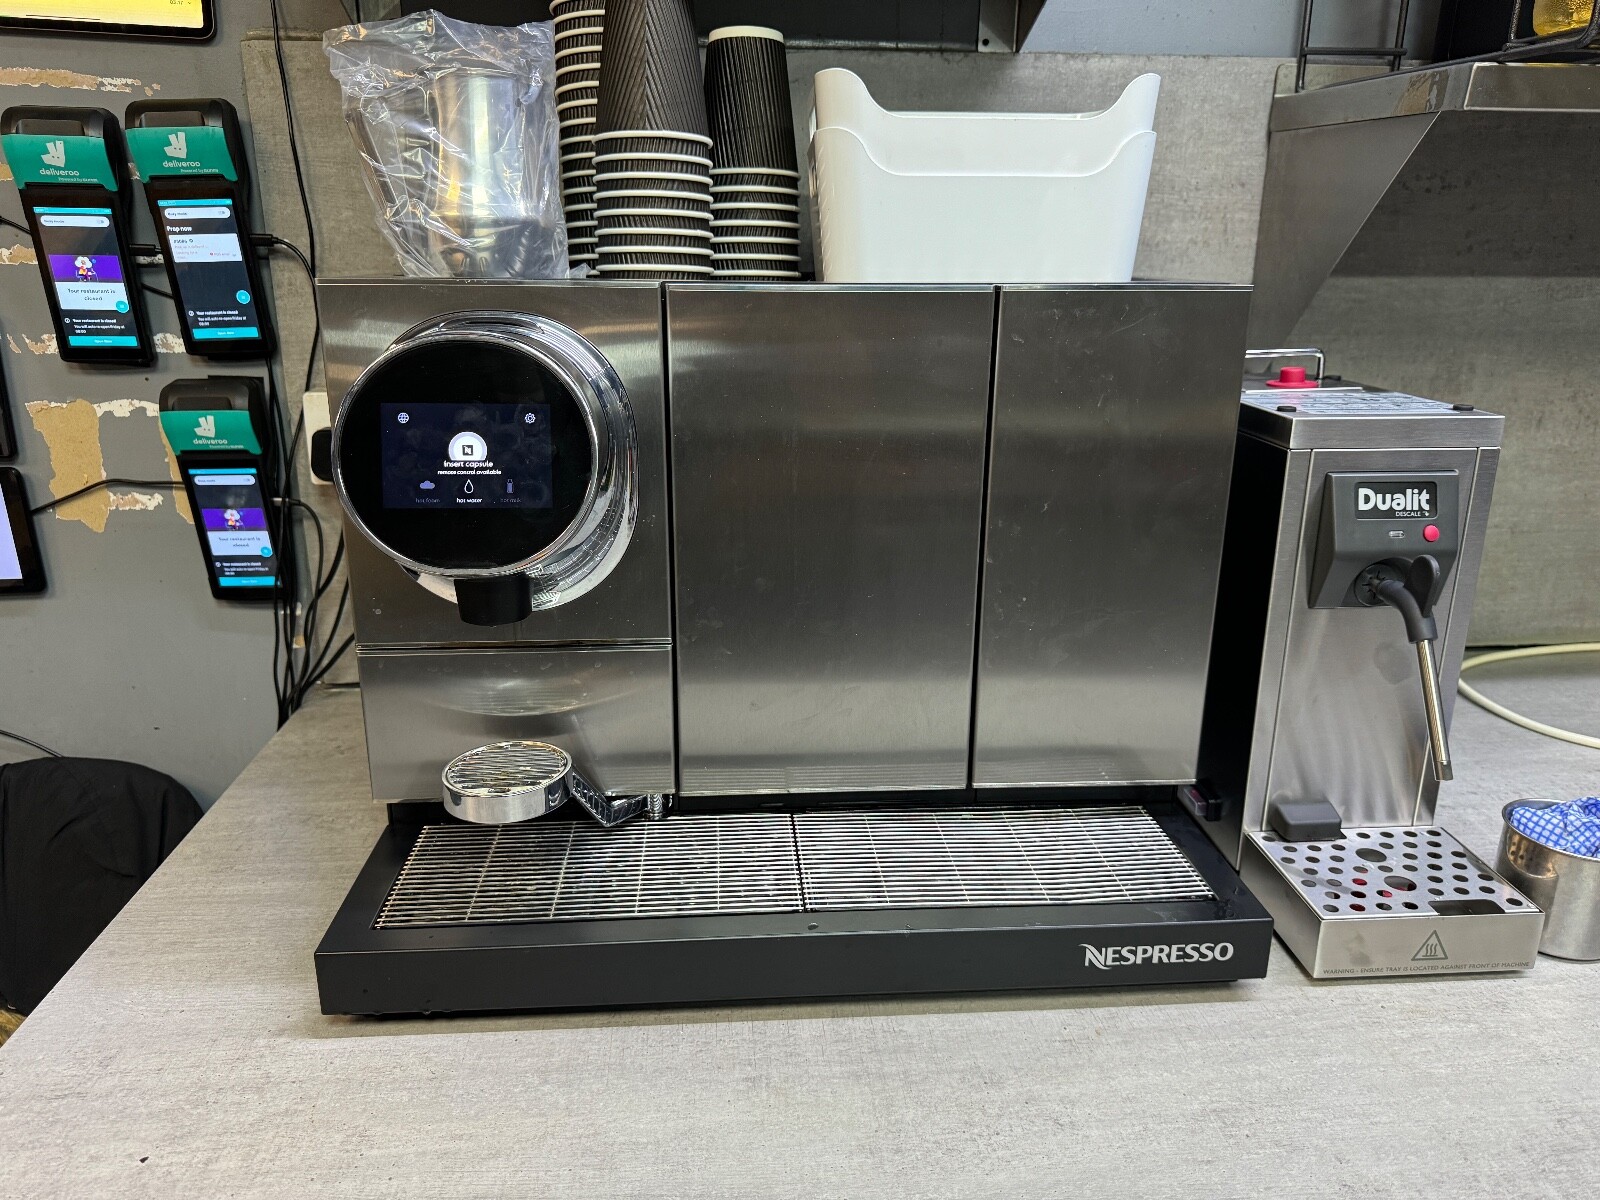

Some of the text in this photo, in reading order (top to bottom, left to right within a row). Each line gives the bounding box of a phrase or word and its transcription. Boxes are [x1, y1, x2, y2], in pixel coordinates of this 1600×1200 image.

[163, 160, 201, 168] deliveroo
[40, 168, 80, 176] deliveroo
[466, 460, 494, 469] capsule
[1358, 488, 1430, 511] Dualit
[1079, 942, 1234, 970] NESPRESSO
